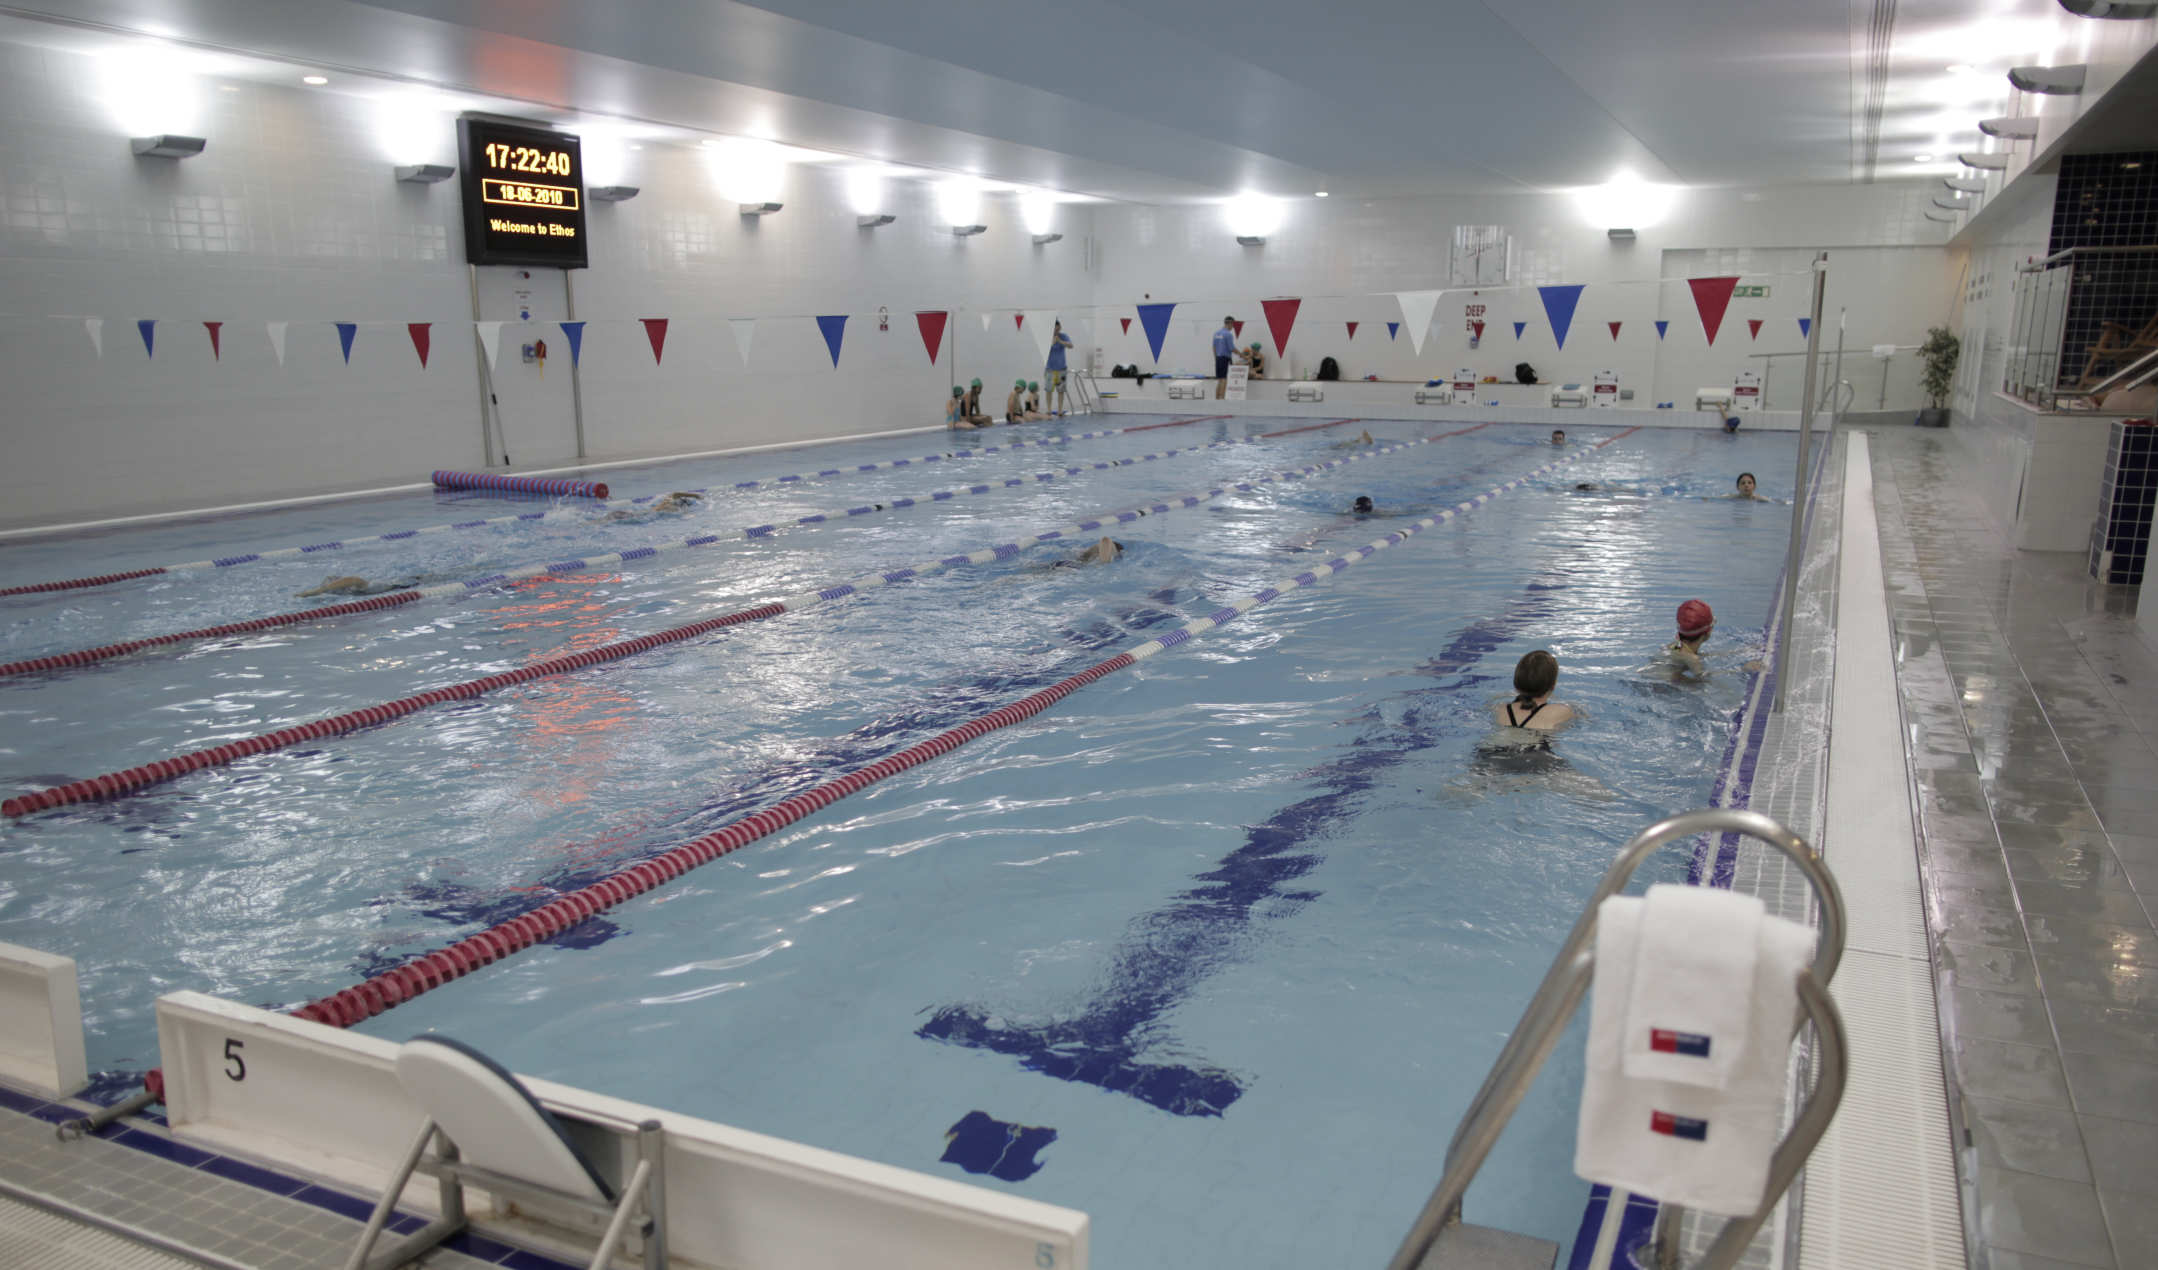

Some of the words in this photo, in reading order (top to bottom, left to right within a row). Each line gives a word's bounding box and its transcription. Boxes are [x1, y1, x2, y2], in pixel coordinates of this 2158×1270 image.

[486, 143, 571, 176] 17:22:40
[500, 184, 563, 205] 18-06-2010
[490, 218, 536, 235] Welcome
[537, 222, 547, 235] to
[549, 223, 575, 237] Ethos
[1466, 304, 1486, 317] DEEP
[225, 1038, 246, 1082] 5
